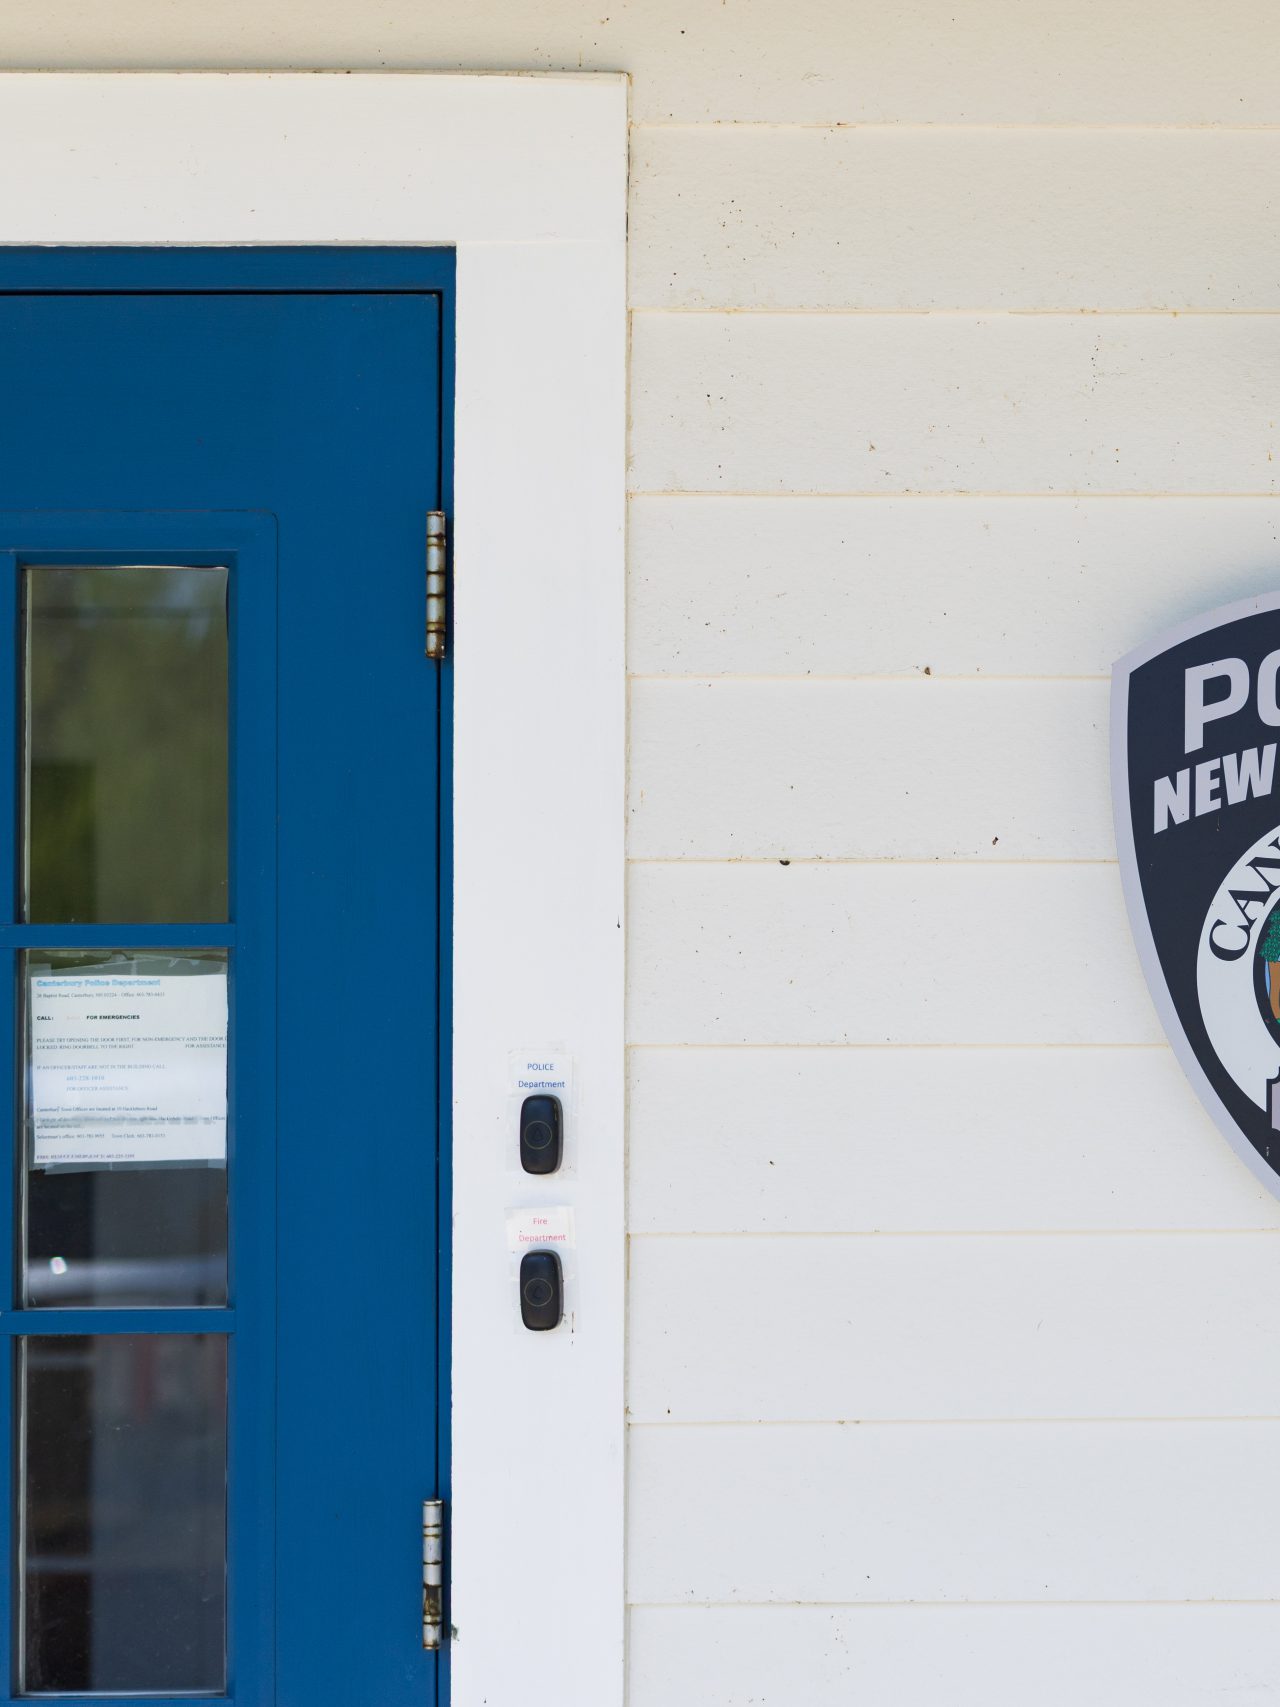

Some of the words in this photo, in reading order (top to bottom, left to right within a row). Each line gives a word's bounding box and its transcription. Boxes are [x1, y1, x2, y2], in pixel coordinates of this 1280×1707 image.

[1153, 743, 1278, 835] NEW
[37, 980, 82, 988] Canterbury
[84, 979, 109, 987] Police
[111, 979, 160, 987] Department
[527, 1063, 554, 1071] POLICE
[518, 1080, 565, 1089] Department
[532, 1217, 548, 1225] Fire
[518, 1234, 566, 1242] Department
